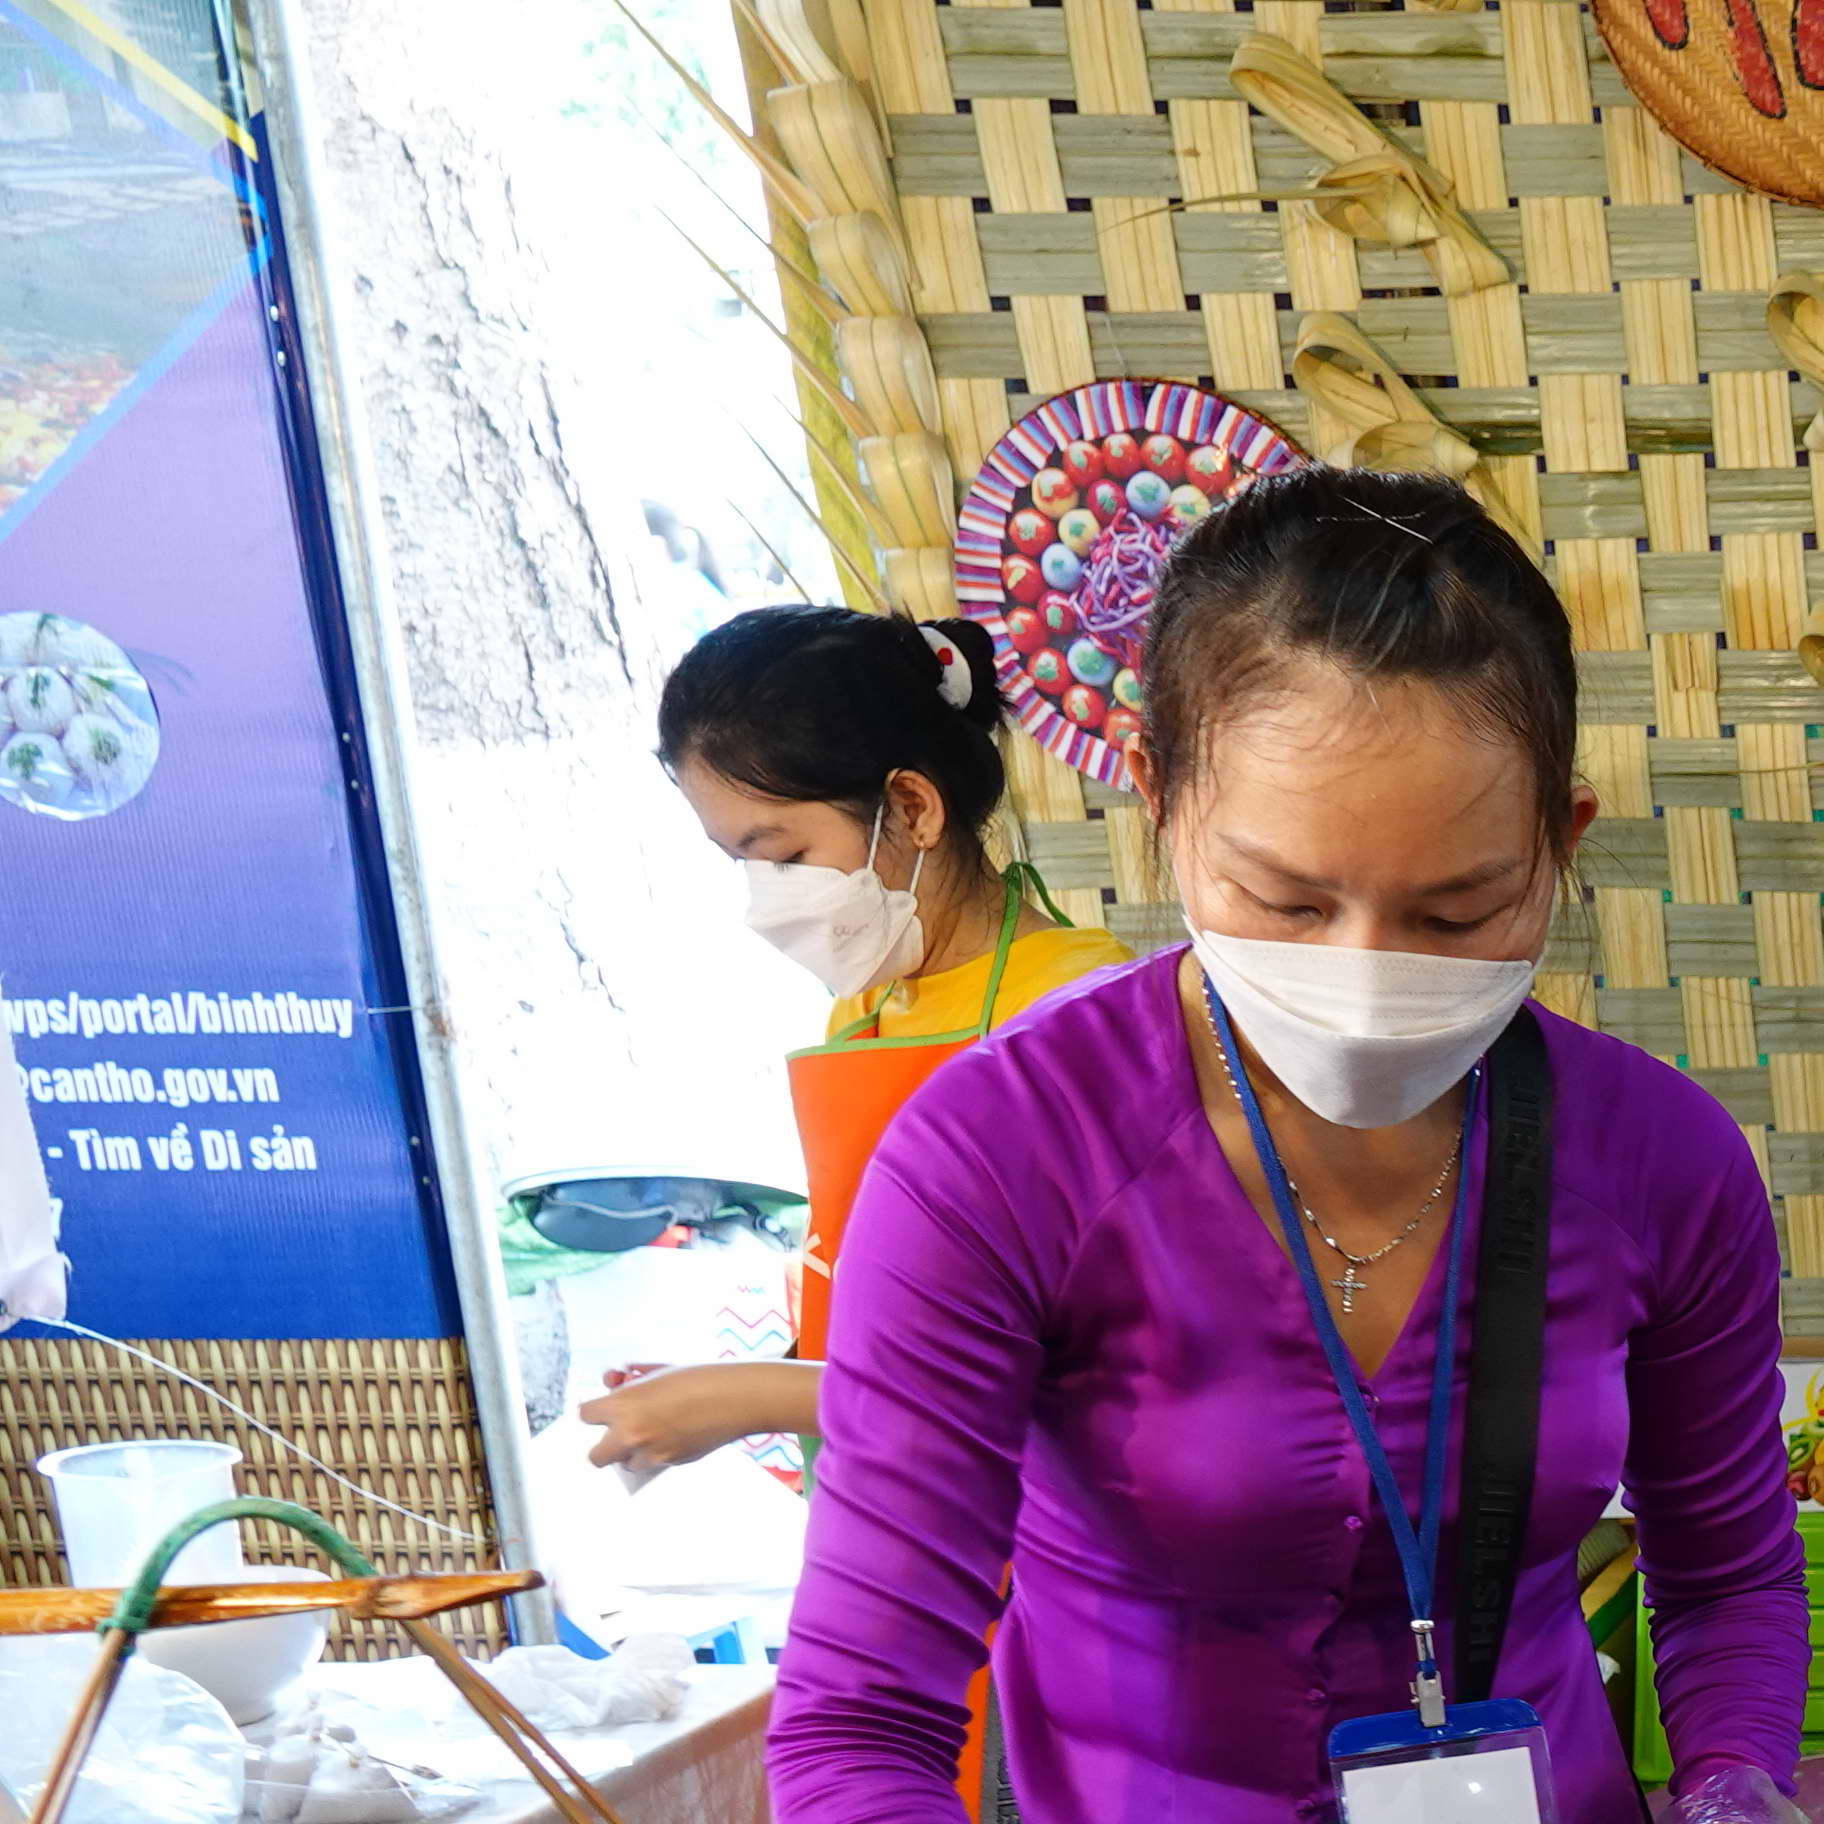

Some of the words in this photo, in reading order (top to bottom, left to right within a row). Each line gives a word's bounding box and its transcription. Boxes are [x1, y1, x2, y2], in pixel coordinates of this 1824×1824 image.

[68, 1127, 142, 1171] Tìm
[146, 1121, 194, 1171] về
[200, 1128, 243, 1171] Di
[249, 1123, 318, 1171] sản
